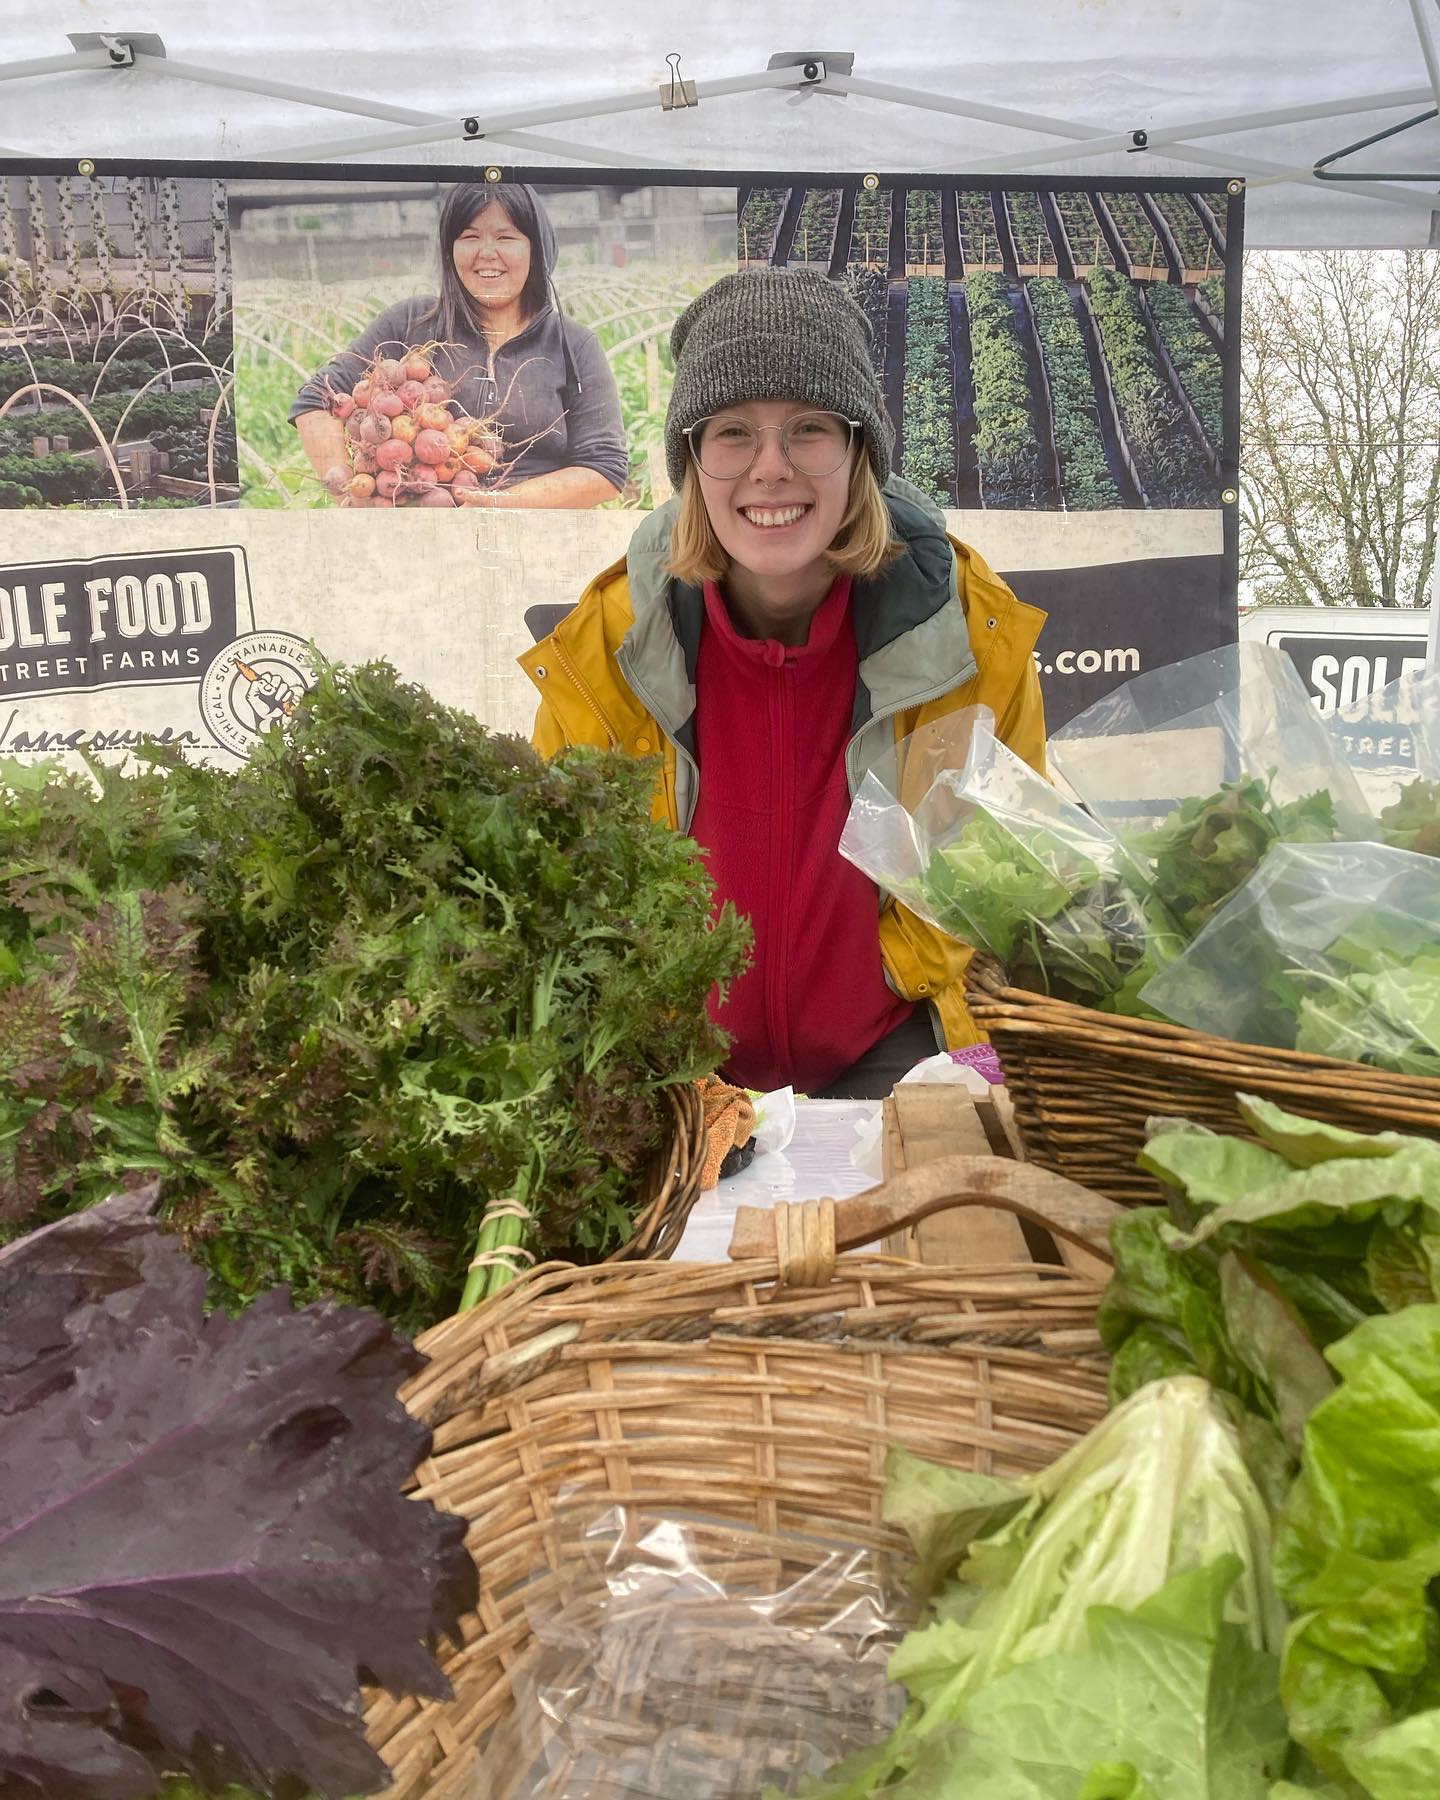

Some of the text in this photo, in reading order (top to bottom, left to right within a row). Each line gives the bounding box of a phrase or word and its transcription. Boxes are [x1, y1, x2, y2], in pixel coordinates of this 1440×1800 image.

[84, 571, 212, 643] FOOD
[102, 647, 200, 671] FARMS
[216, 643, 304, 682] SUSTAINABLE
[1310, 654, 1426, 725] SOLE
[212, 694, 247, 745] ETHICAL
[1329, 732, 1412, 757] TREE
